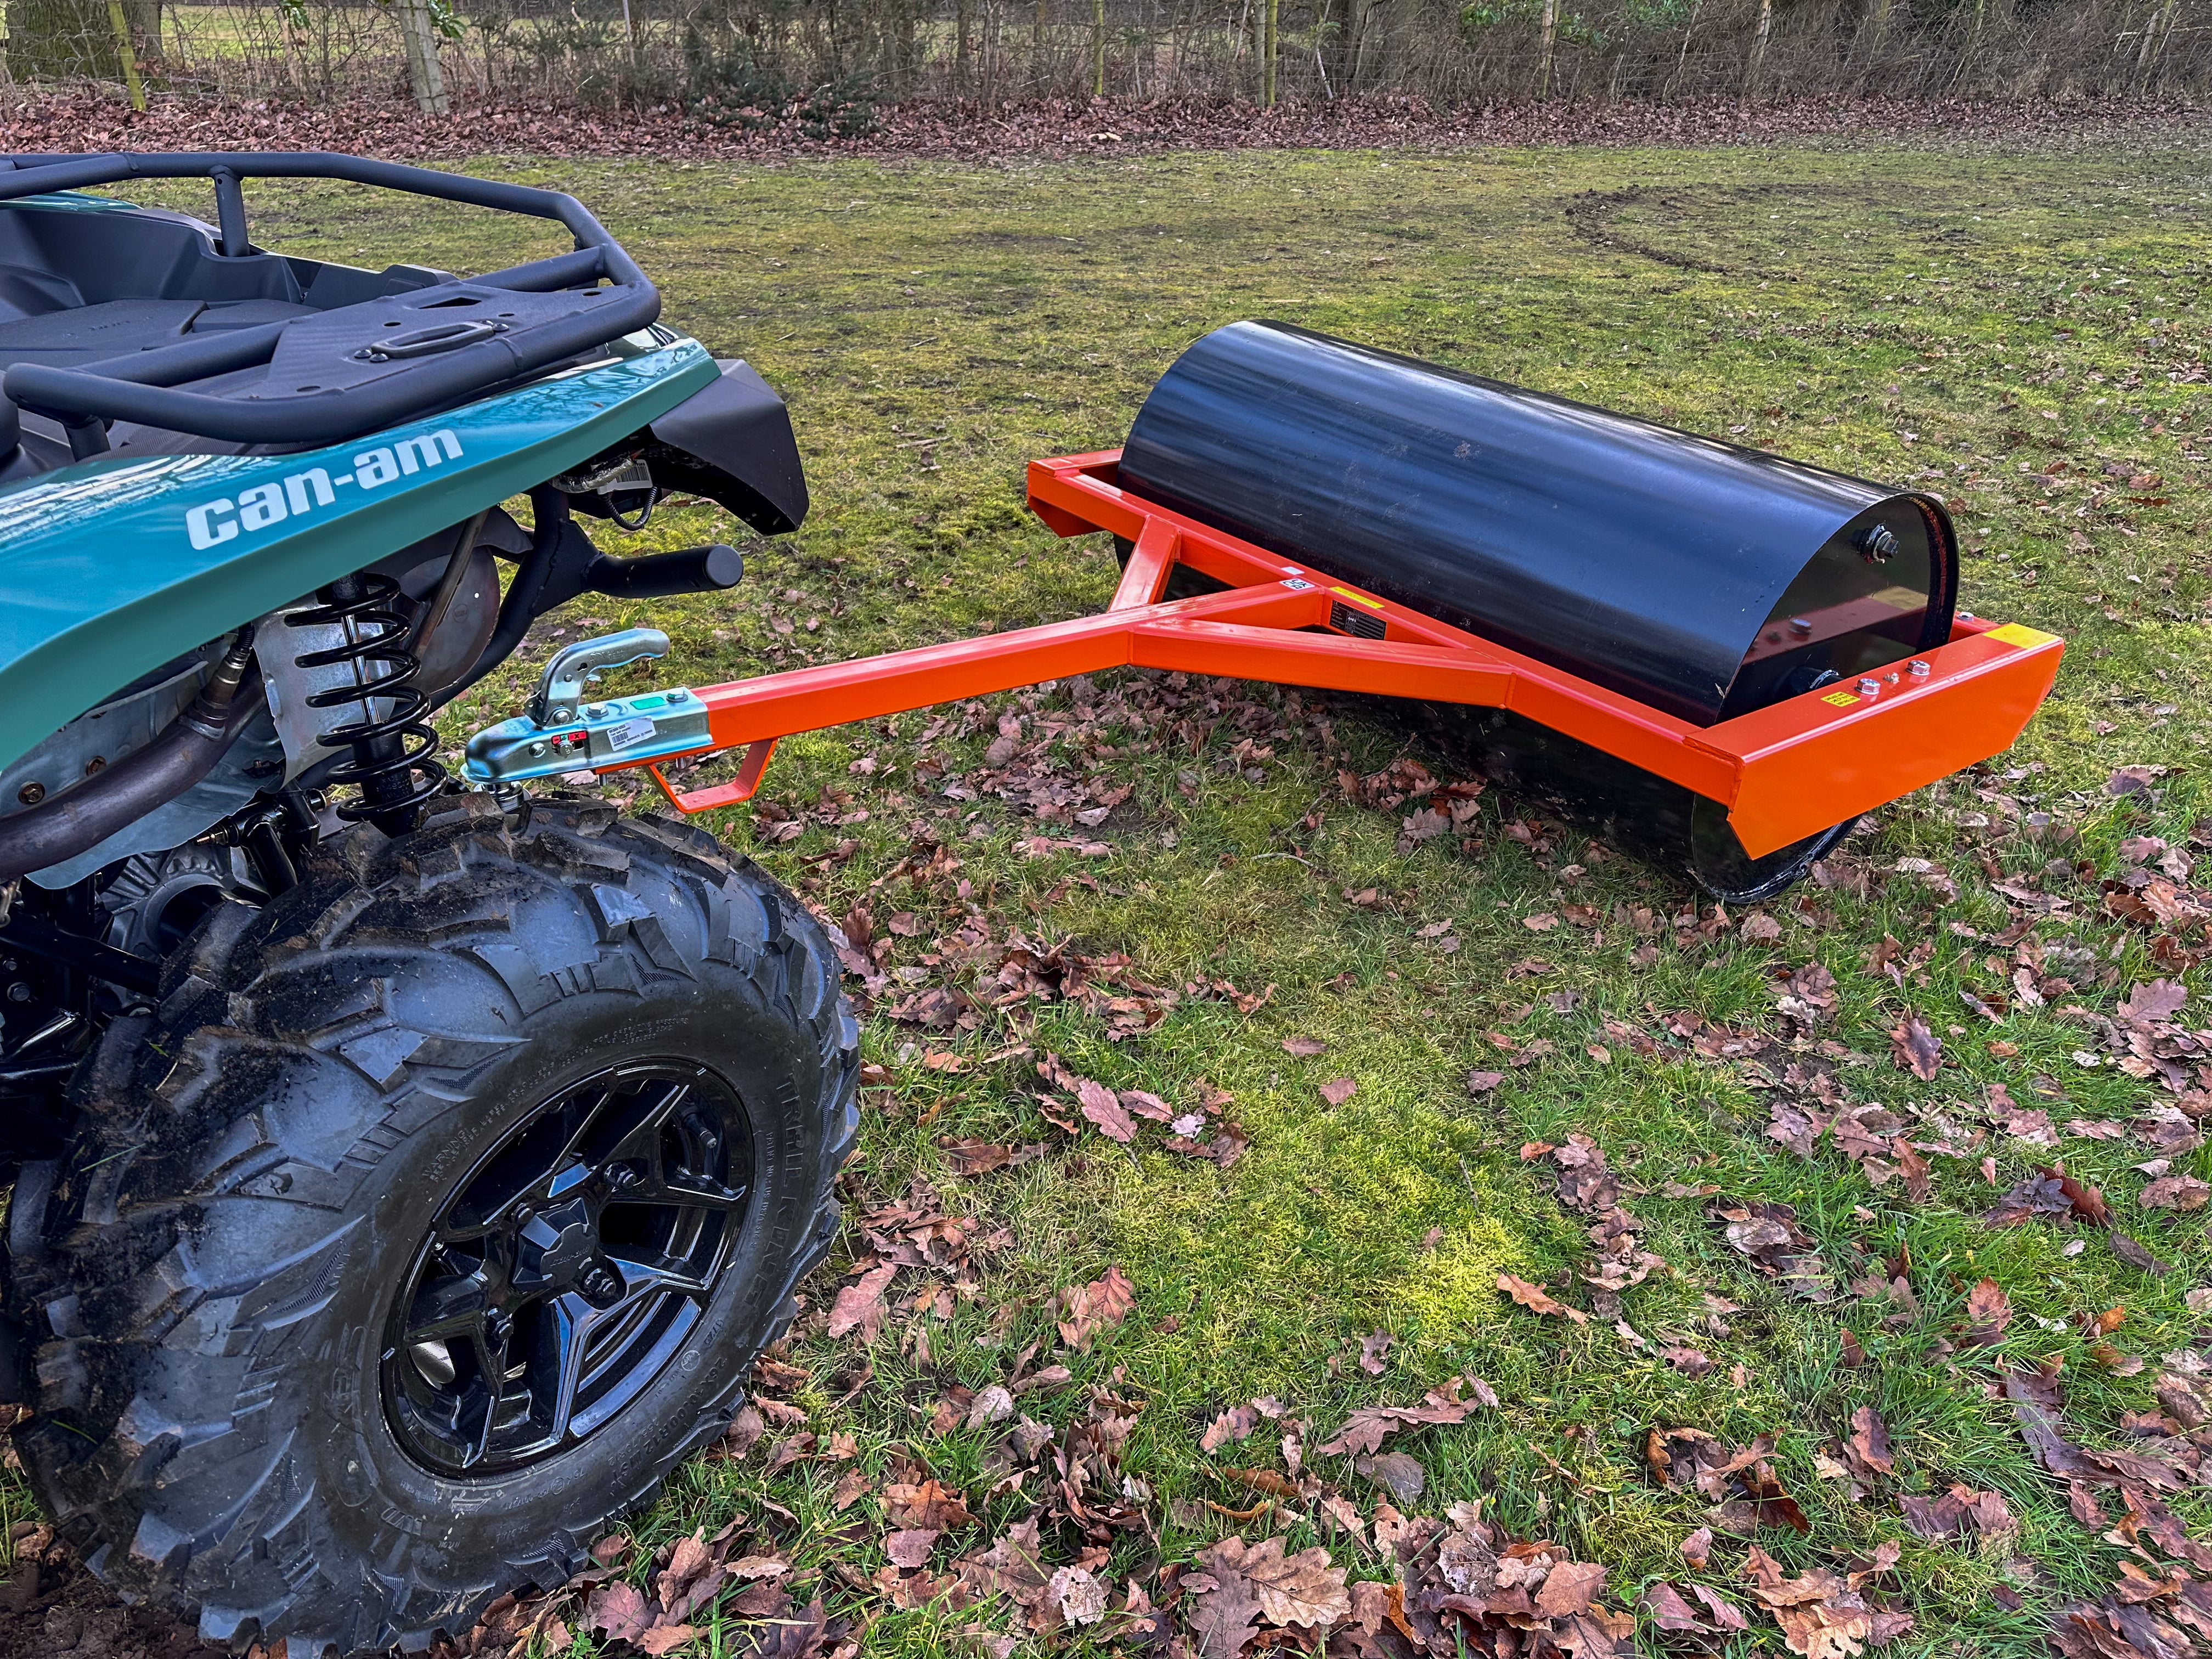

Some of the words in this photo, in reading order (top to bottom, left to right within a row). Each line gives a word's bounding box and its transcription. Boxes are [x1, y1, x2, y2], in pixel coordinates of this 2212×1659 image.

[185, 428, 464, 551] can-am
[1283, 581, 1303, 589] CA
[1291, 579, 1312, 588] UK
[776, 1073, 804, 1187] TRAIL
